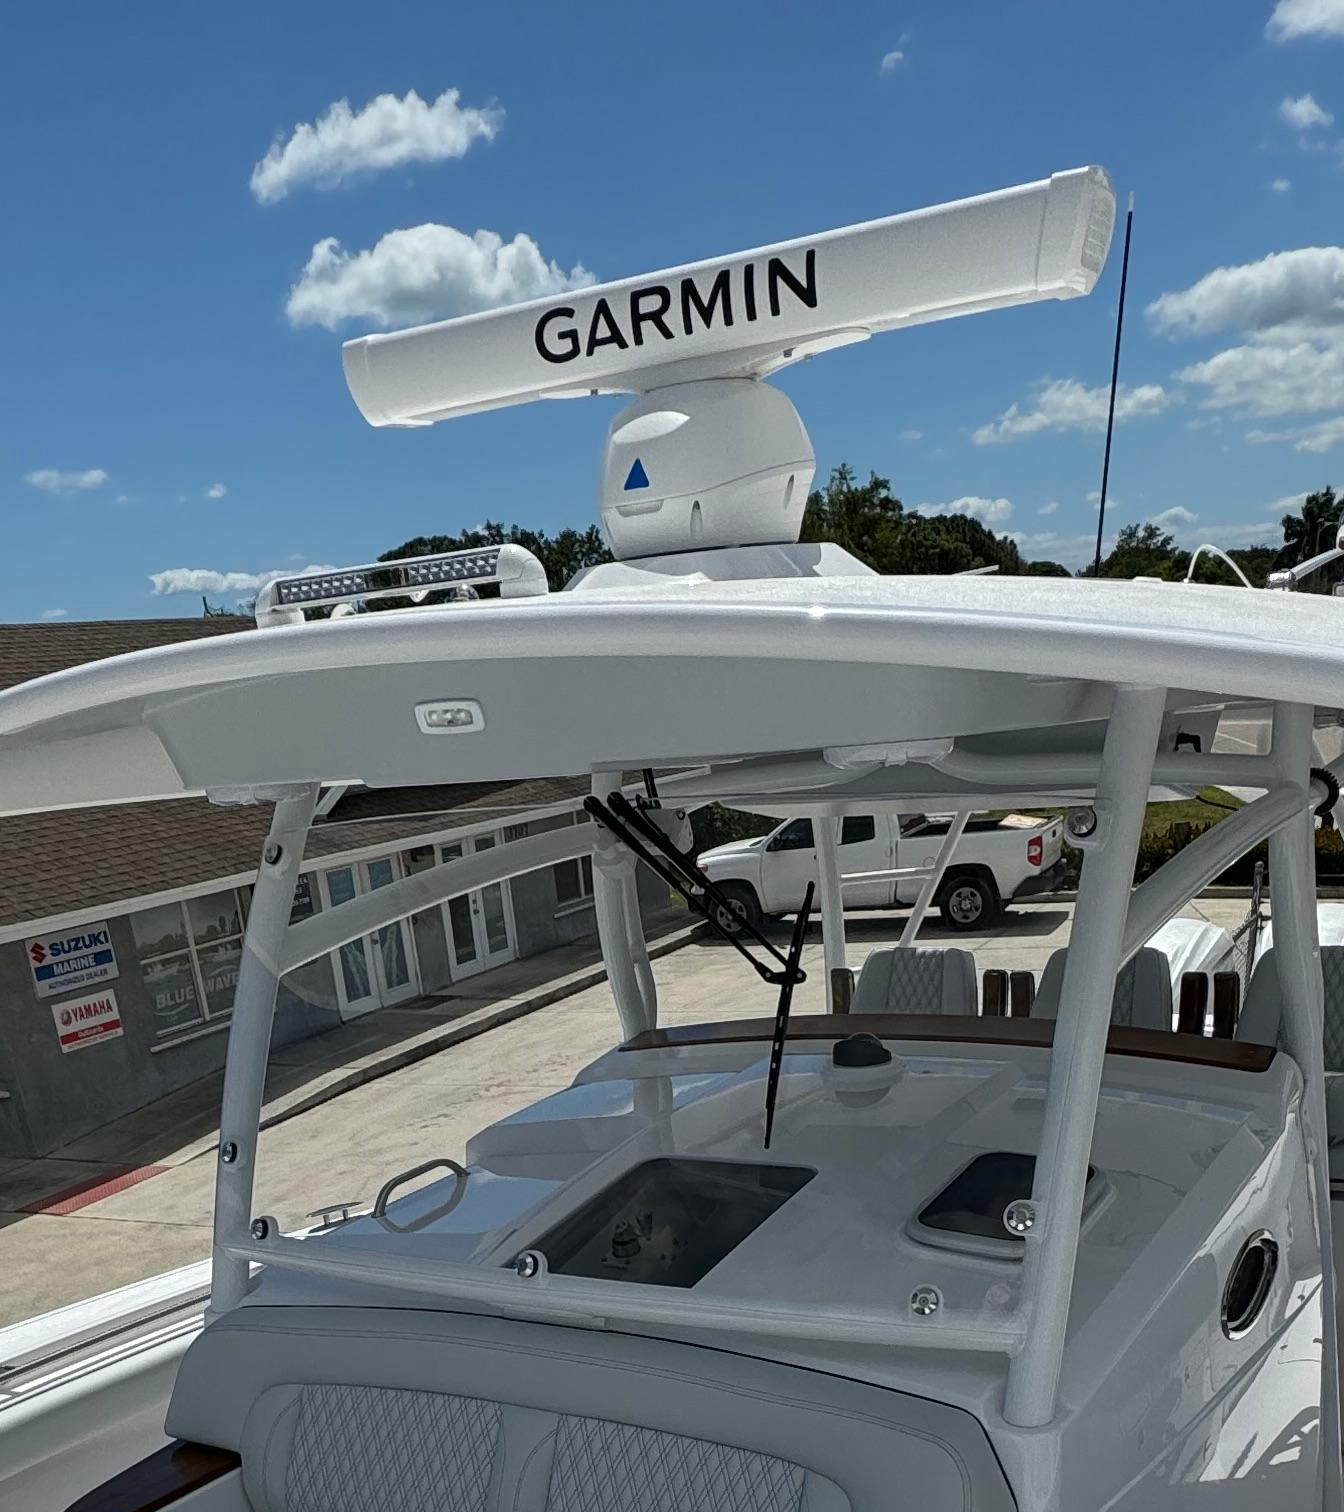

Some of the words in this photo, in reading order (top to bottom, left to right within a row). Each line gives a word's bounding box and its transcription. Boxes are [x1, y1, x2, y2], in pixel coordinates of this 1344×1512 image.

[534, 248, 819, 364] GARMIN
[49, 931, 109, 957] SUZUKI
[53, 954, 96, 976] MARINE
[156, 986, 196, 1010] BLUE
[72, 999, 113, 1022] YAMAHA
